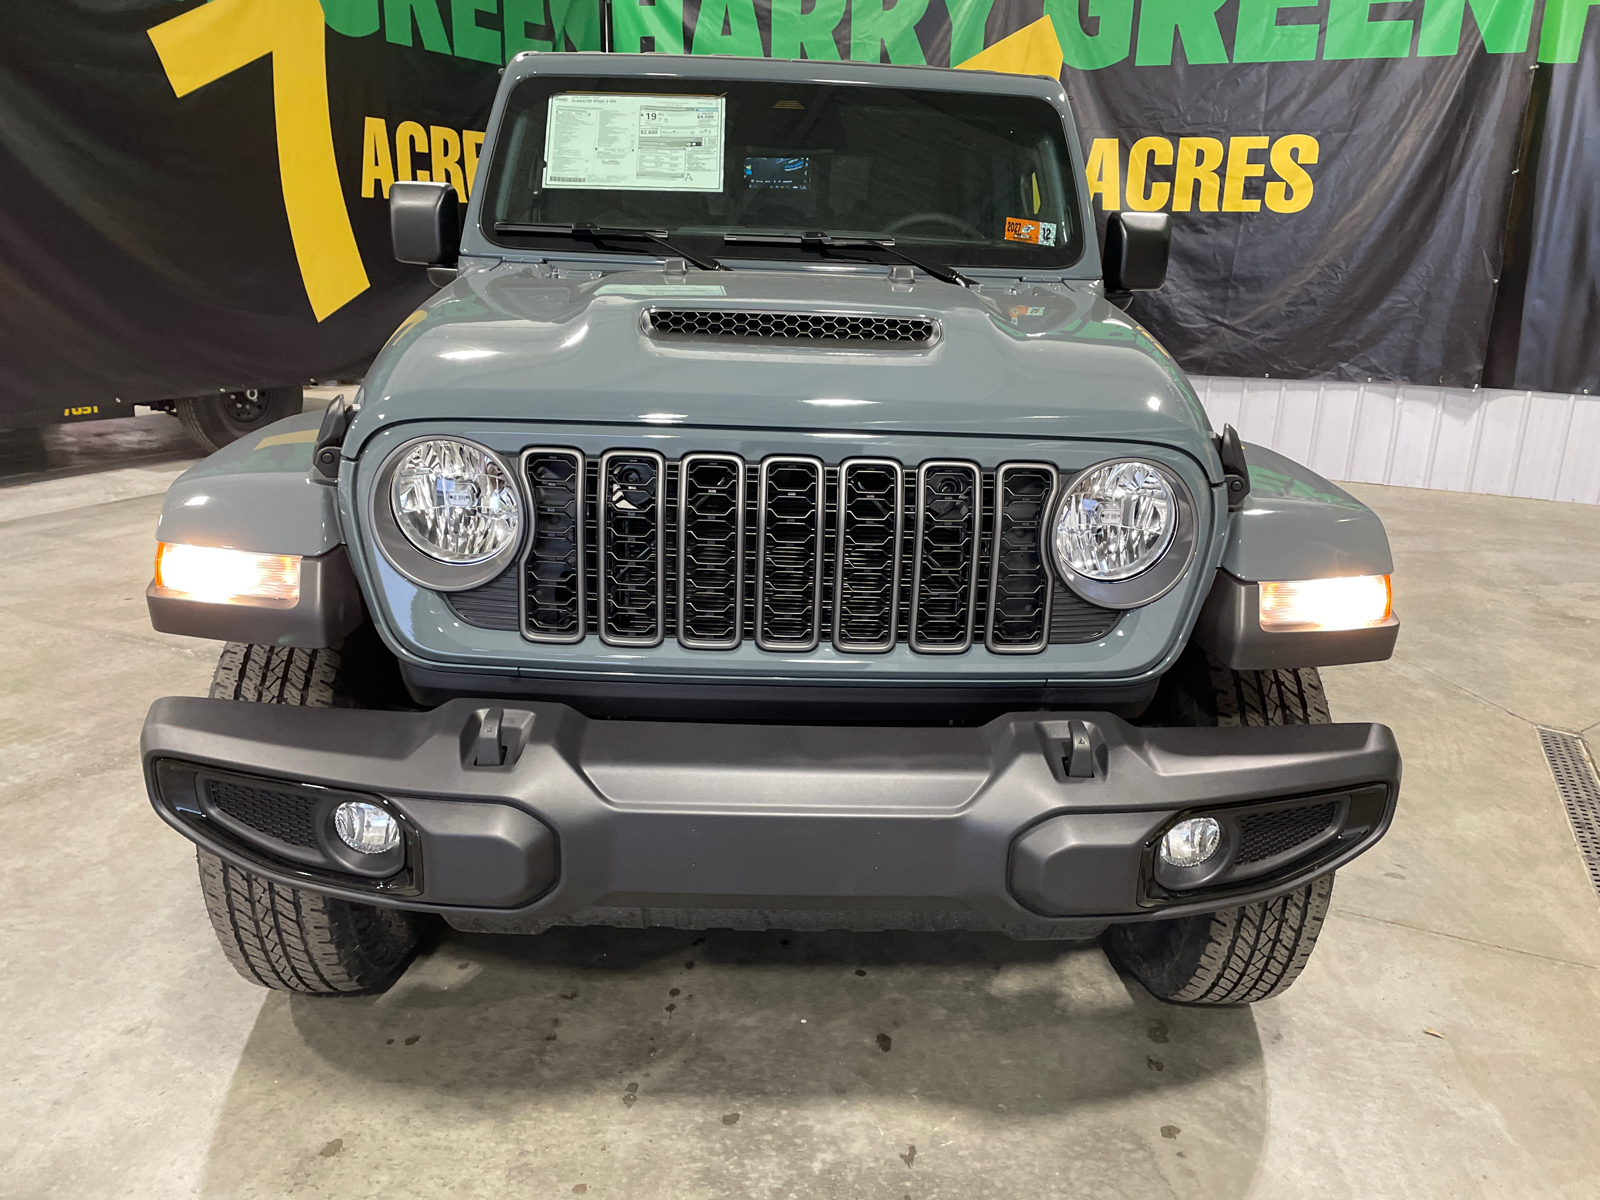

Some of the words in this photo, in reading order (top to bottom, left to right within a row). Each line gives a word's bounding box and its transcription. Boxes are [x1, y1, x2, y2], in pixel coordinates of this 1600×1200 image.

[646, 112, 657, 120] 19
[361, 116, 486, 203] ACRE
[1085, 134, 1320, 213] ACRES
[1007, 221, 1021, 233] 2027
[1042, 227, 1051, 241] 12
